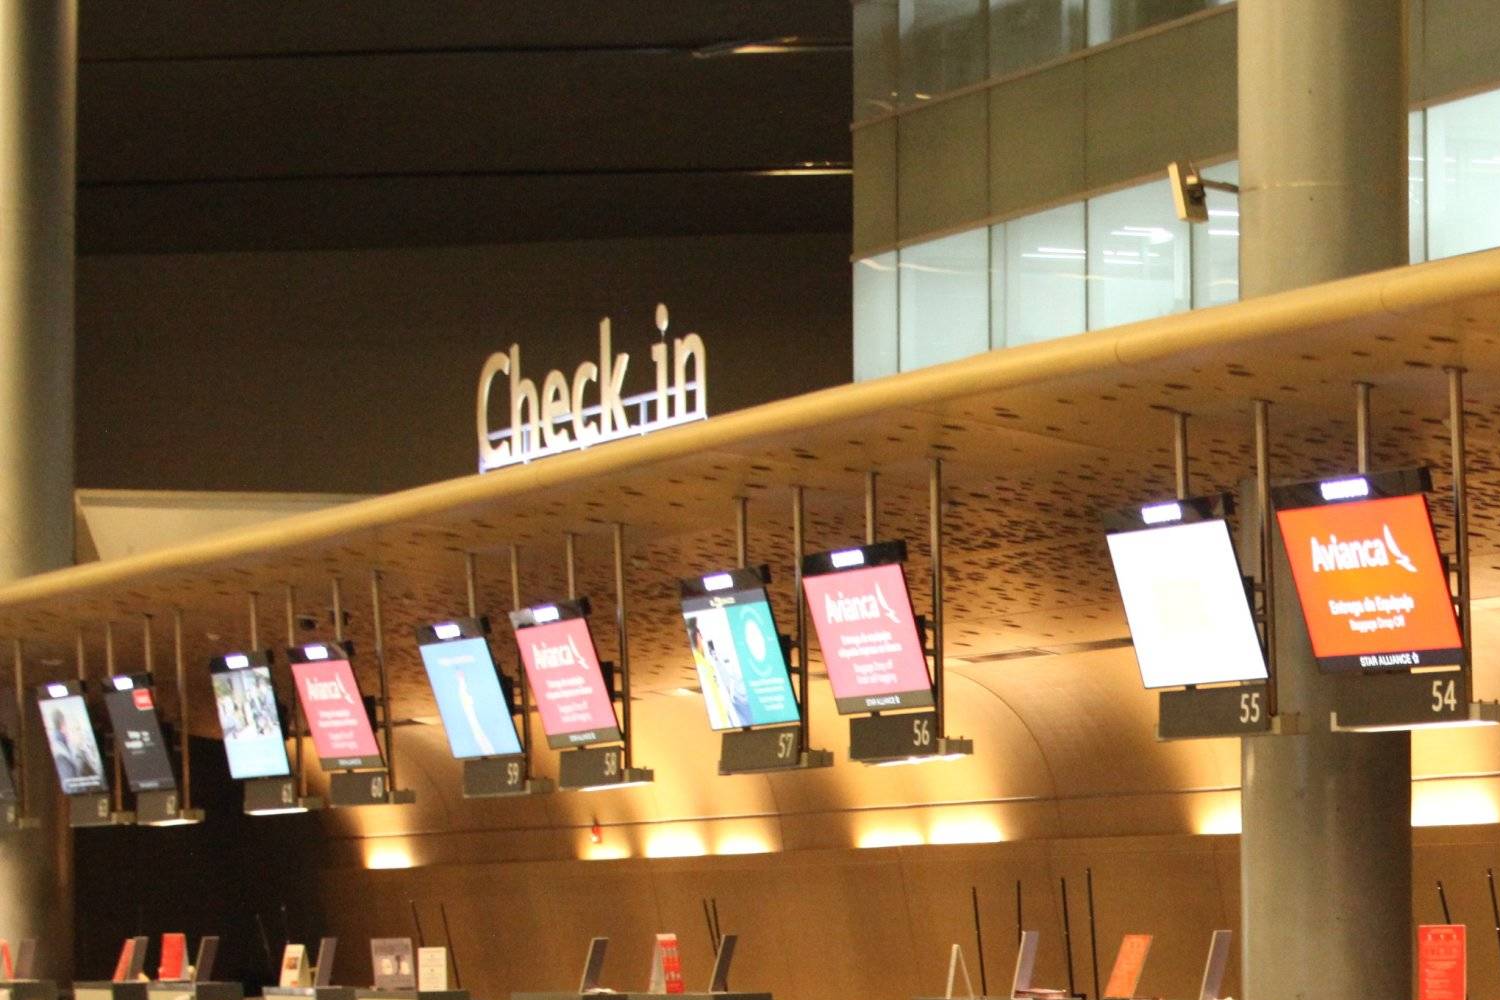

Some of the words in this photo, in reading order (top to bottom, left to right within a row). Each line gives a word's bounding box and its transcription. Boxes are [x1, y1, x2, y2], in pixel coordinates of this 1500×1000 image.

[477, 316, 630, 462] Check
[651, 303, 707, 425] in
[1310, 534, 1389, 572] Avianca
[824, 591, 880, 624] Avianca
[1360, 654, 1378, 667] STAR
[1378, 653, 1413, 666] ALLIANCE
[1239, 692, 1260, 723] 55
[1431, 680, 1457, 712] 54
[777, 732, 794, 759] 57
[912, 719, 930, 747] 56
